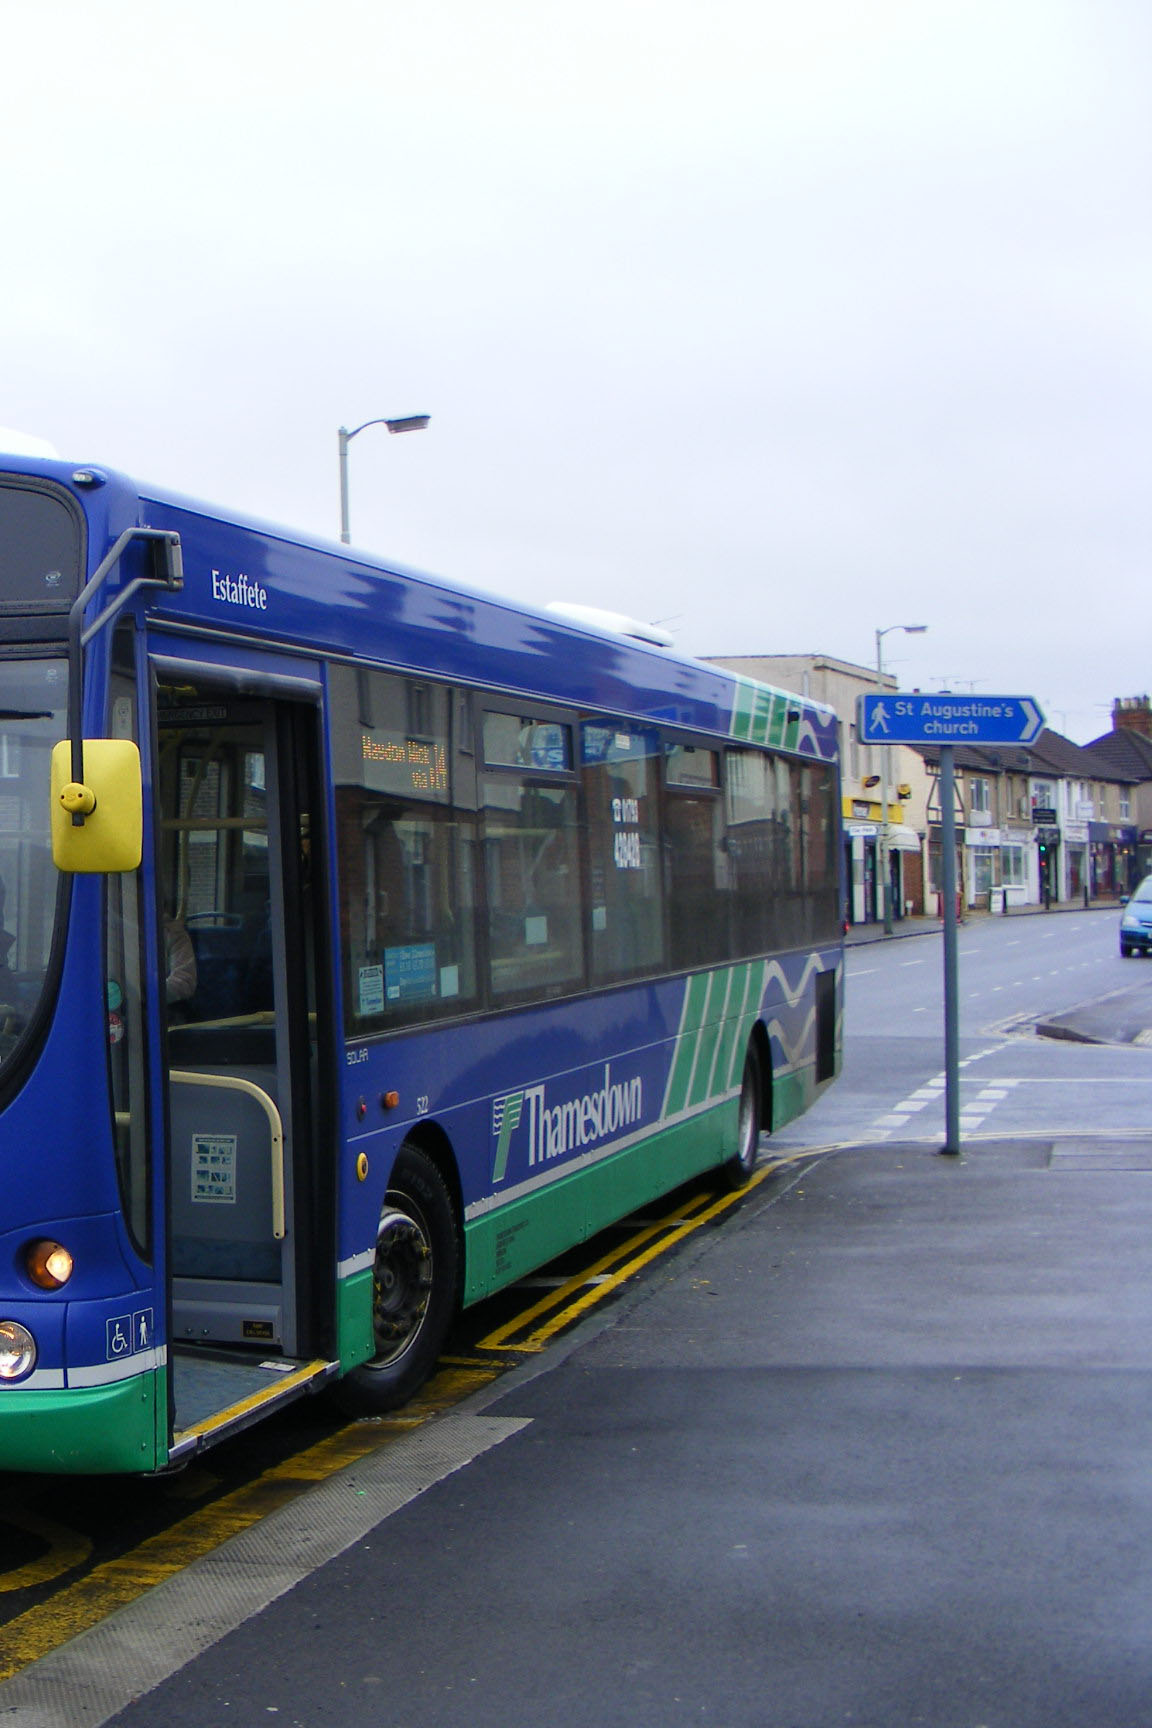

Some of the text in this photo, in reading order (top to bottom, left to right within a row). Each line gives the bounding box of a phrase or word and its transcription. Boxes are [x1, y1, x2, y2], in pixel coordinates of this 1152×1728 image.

[211, 569, 267, 610] Estaffete
[895, 702, 1014, 718] St Augustine's
[923, 720, 979, 734] church
[347, 1048, 369, 1065] SOLAR
[416, 1095, 429, 1115] 522
[524, 1063, 643, 1167] Thamesdown
